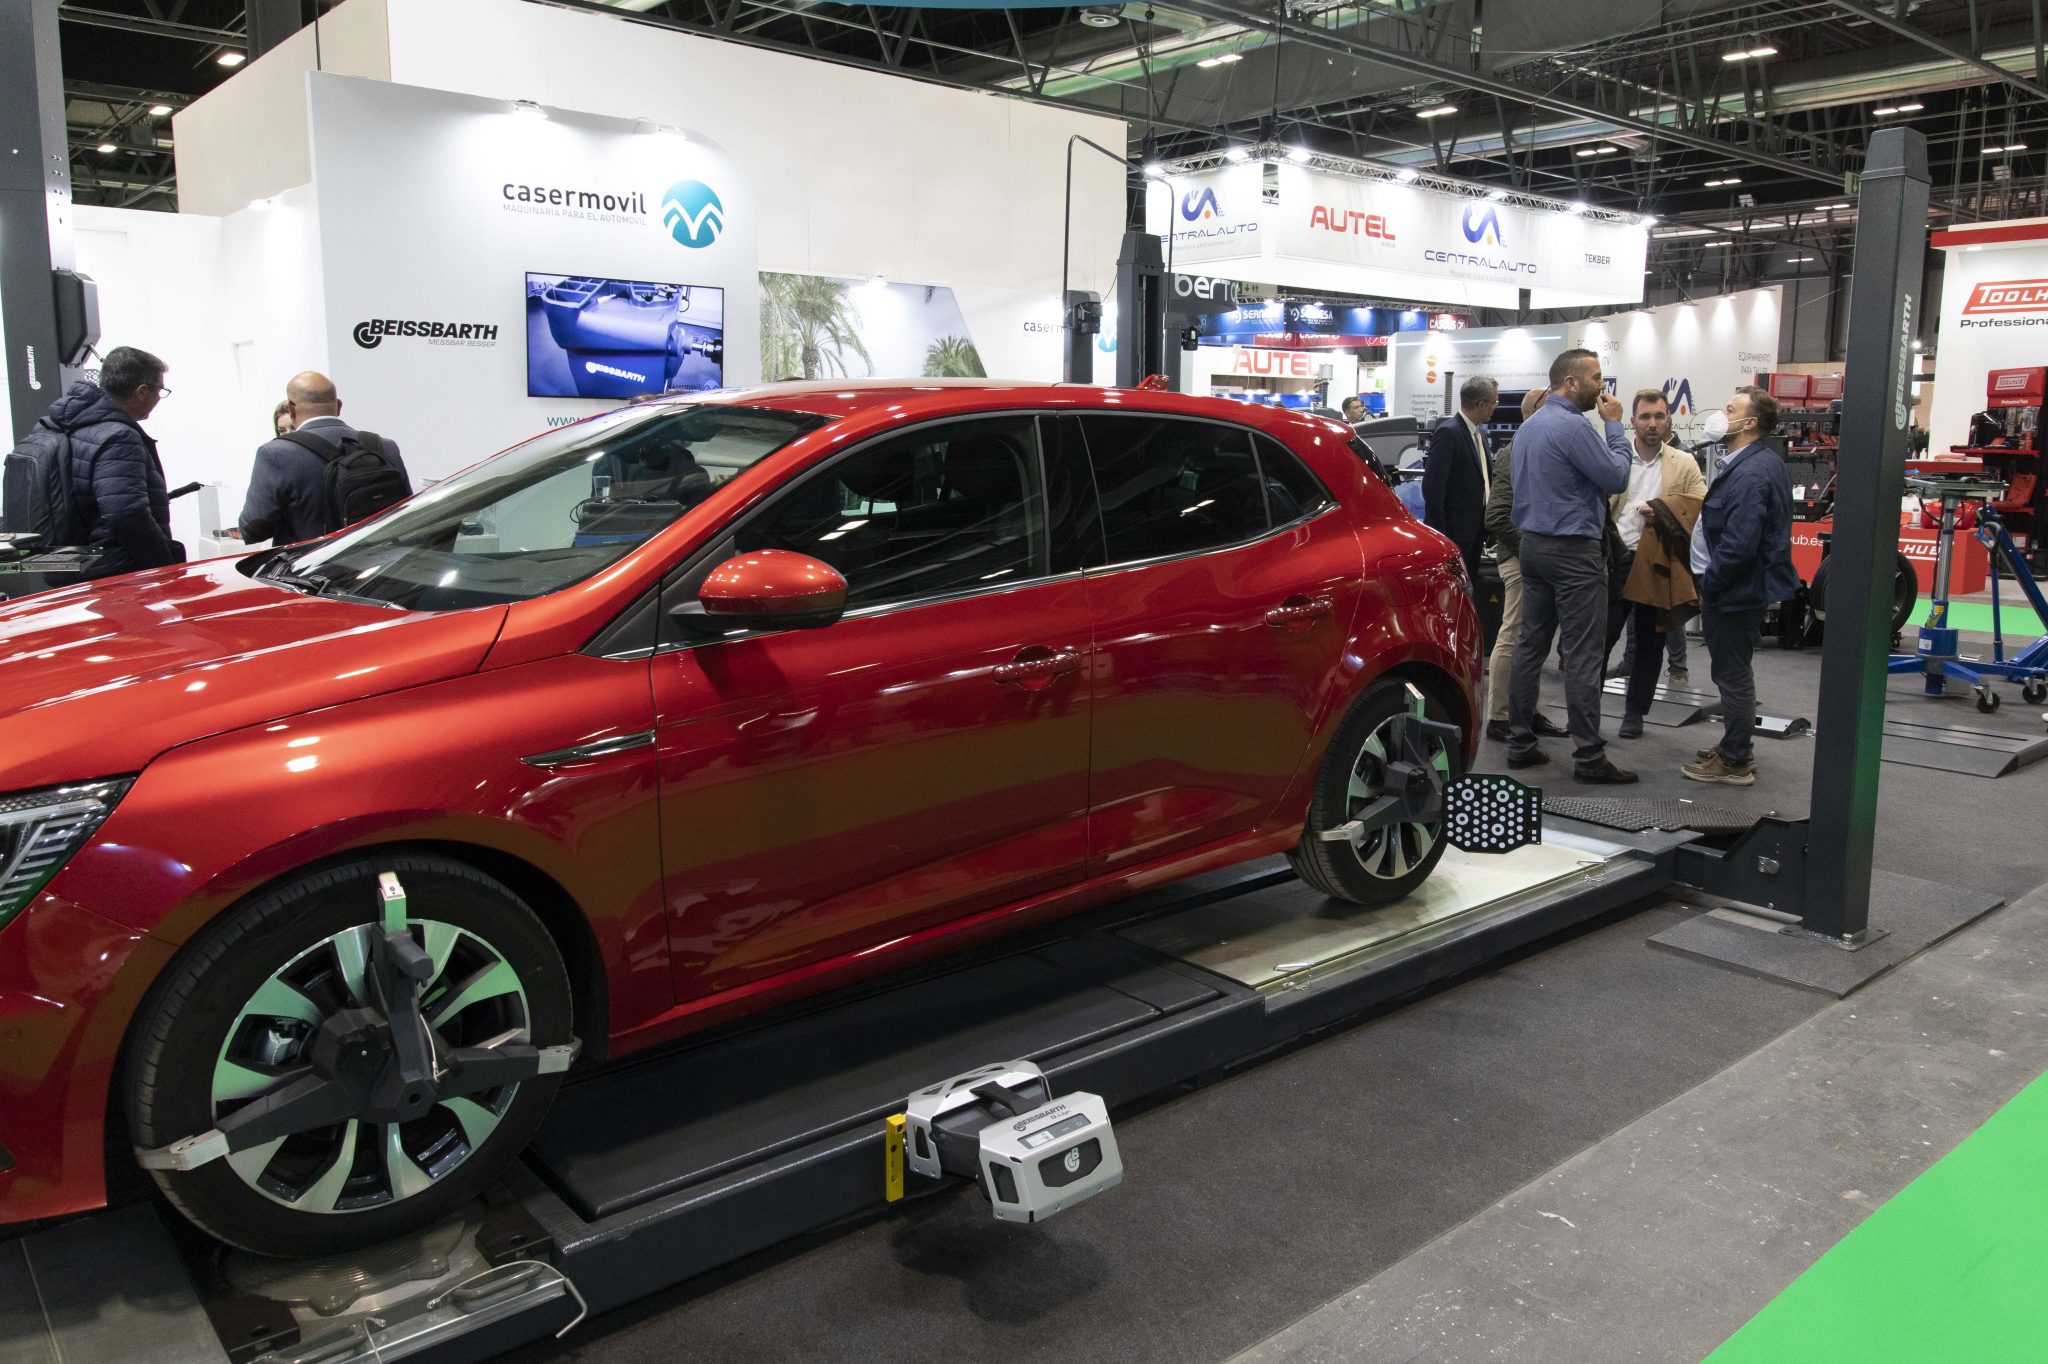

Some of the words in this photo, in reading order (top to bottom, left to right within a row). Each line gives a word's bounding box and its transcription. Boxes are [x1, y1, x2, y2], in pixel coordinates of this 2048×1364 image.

[502, 183, 647, 215] casermovil
[502, 203, 560, 217] MAQUINARIA
[562, 209, 585, 221] PARA
[587, 212, 598, 221] EL
[1310, 205, 1396, 240] AUTEL
[1424, 249, 1537, 274] CENTRALAUTO
[1584, 253, 1611, 265] TEKBER
[369, 318, 499, 340] BEISSBARTH
[428, 338, 465, 347] MESSBAR
[466, 340, 497, 348] BESSER
[1894, 293, 1912, 417] BEISSBARTH
[594, 364, 646, 383] BEISSBARTH
[1232, 350, 1319, 377] AUTEL
[1016, 1104, 1067, 1129] BEISSBARTH
